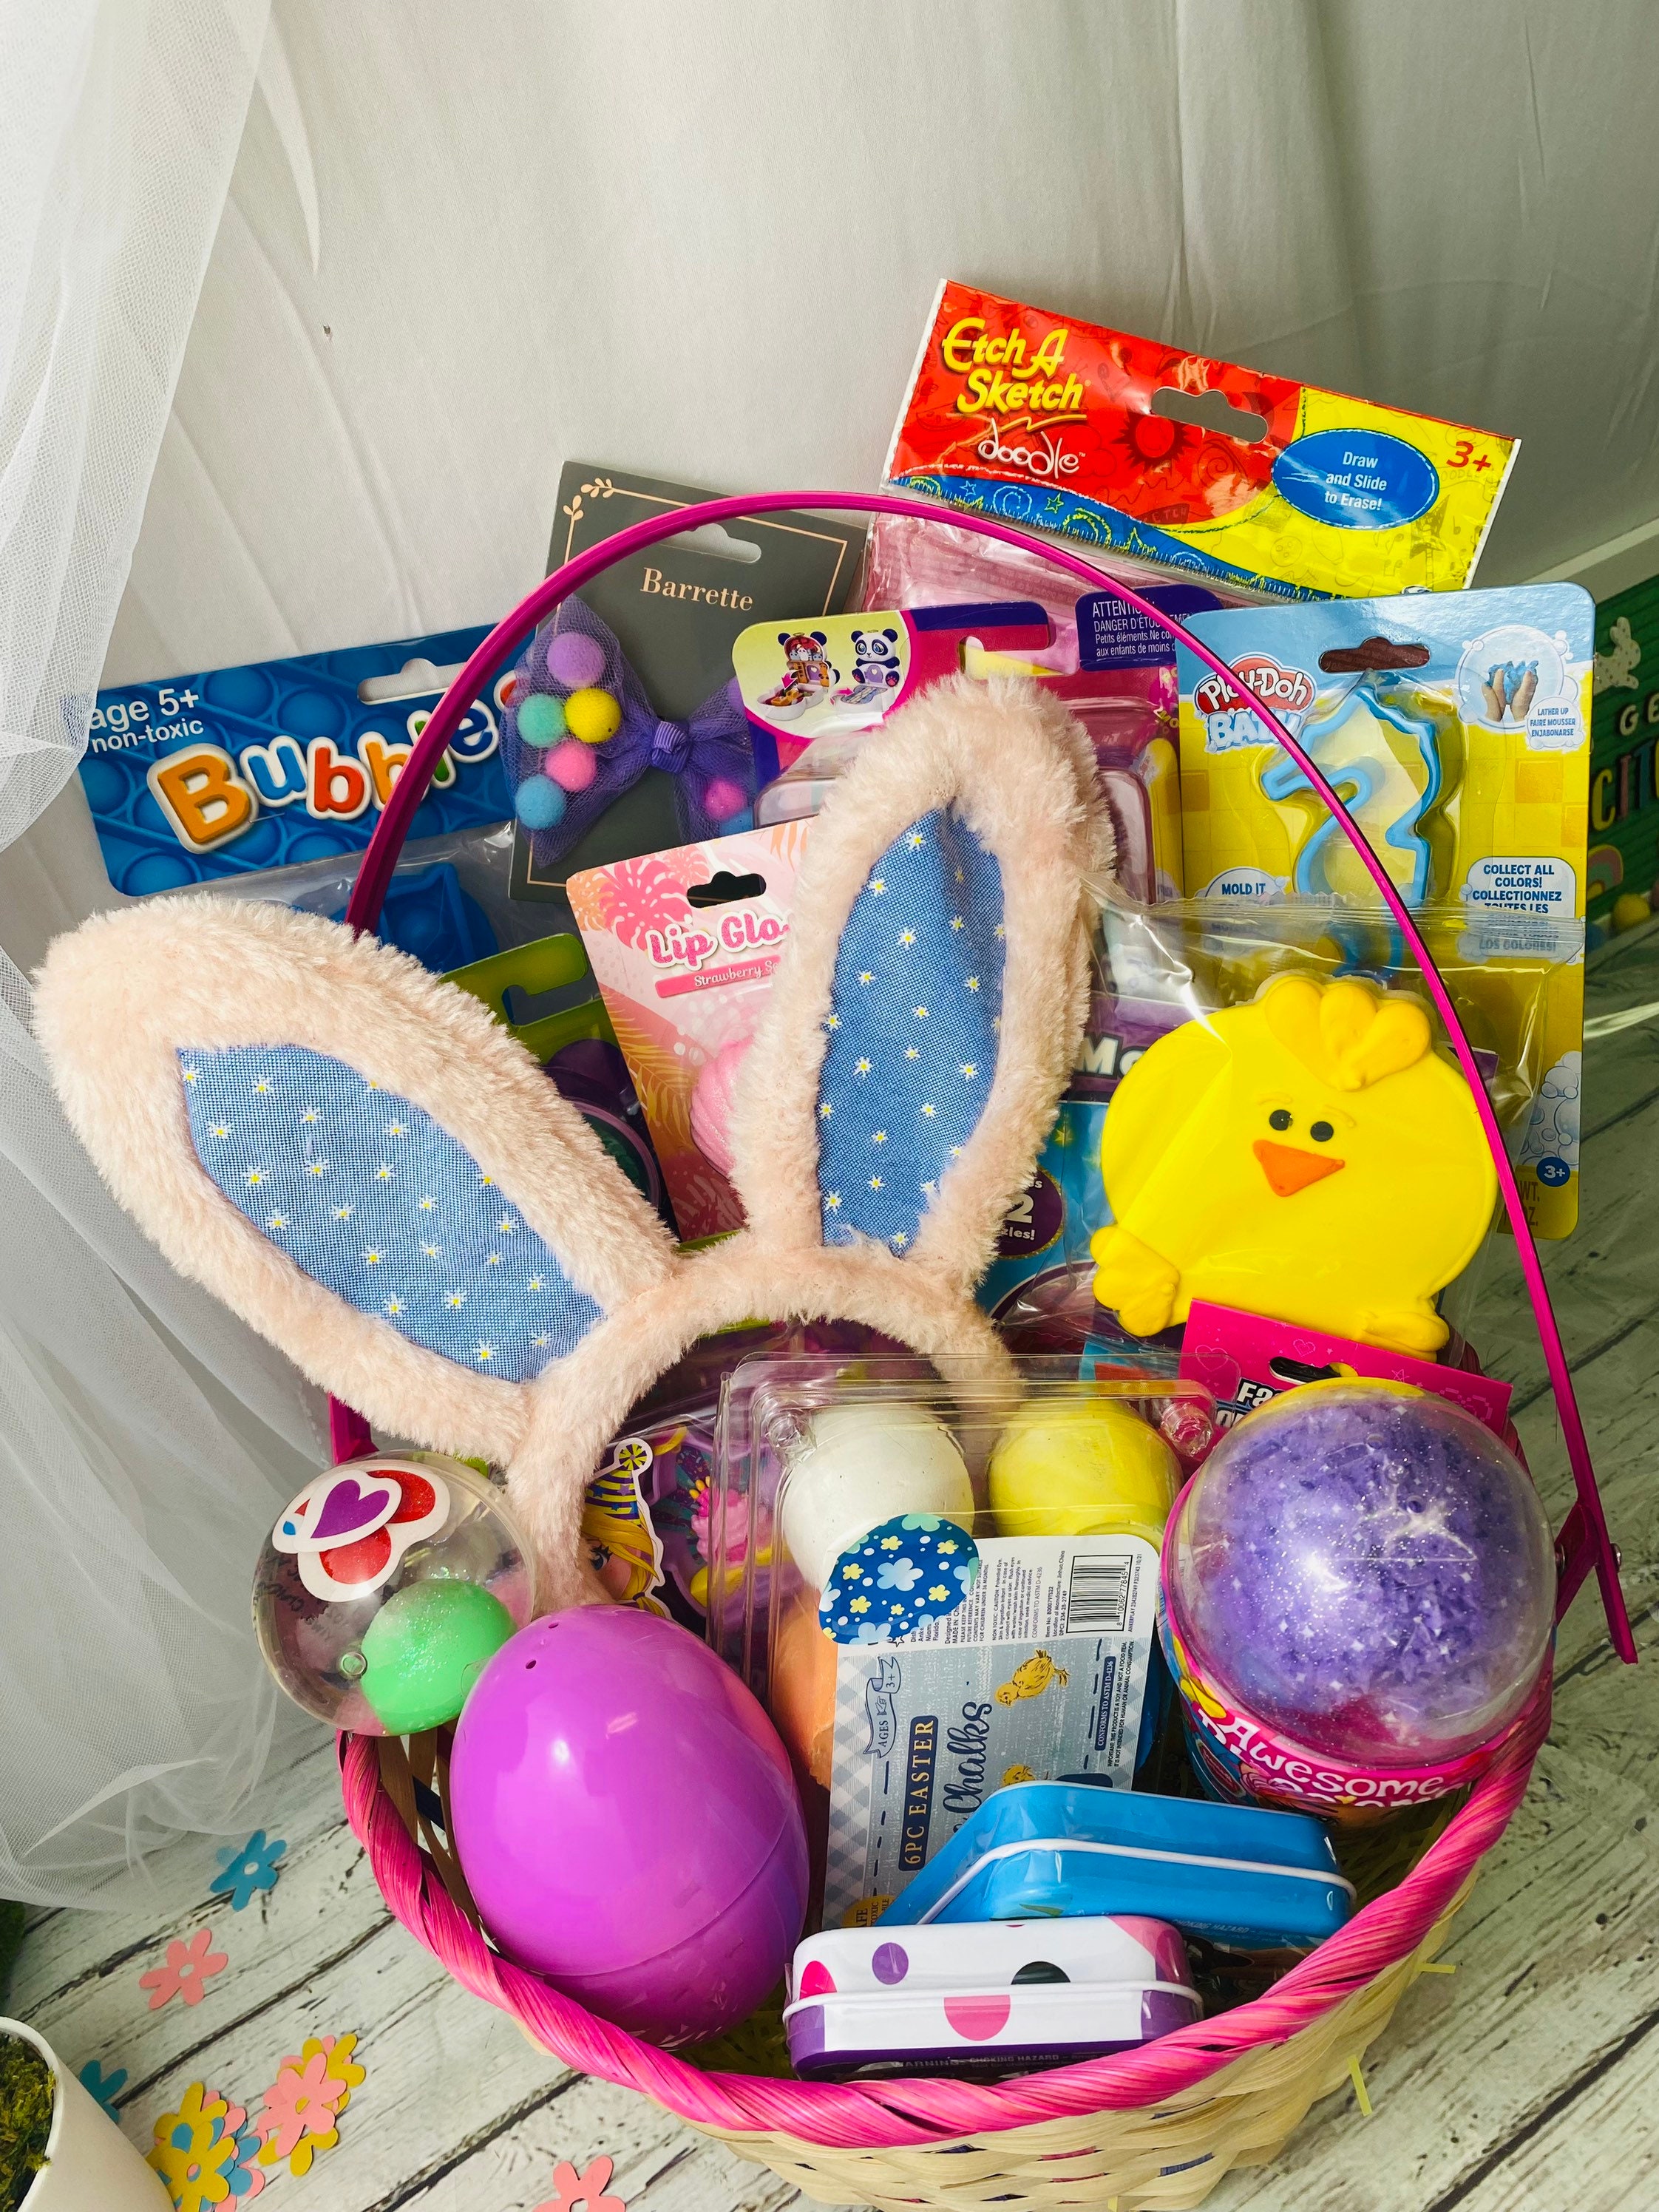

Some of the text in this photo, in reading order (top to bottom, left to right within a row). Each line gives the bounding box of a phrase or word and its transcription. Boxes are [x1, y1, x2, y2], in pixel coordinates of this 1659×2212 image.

[941, 317, 1069, 380] Etch A
[1343, 451, 1379, 469] Draw
[1446, 441, 1492, 472] 3+
[1326, 473, 1388, 491] and Slide
[1324, 491, 1382, 511] to Erase!
[640, 567, 754, 612] Barrette
[1094, 618, 1129, 633] DANGER
[1096, 634, 1115, 644] Petits
[1096, 648, 1109, 657] aux
[1110, 645, 1136, 657] enfants
[1138, 642, 1146, 654] de
[1148, 641, 1170, 653] moins
[89, 688, 200, 733] age 5+
[1538, 708, 1559, 716] LATHER
[1547, 718, 1575, 726] MOUSSER
[92, 717, 204, 753] non-toxic
[1532, 728, 1574, 737] ENJABONARSE
[1483, 864, 1554, 875] COLLECT ALL
[1222, 883, 1266, 895] MOLD IT
[1495, 877, 1543, 888] COLORS!
[1472, 890, 1561, 901] COLLECTIONNEZ
[648, 912, 791, 968] Lip Glo
[694, 963, 763, 988] Strawberry
[1544, 1164, 1566, 1179] 3+
[1526, 1206, 1538, 1227] Z.
[1119, 1572, 1128, 1592] 77845
[1117, 1594, 1125, 1615] 10062
[886, 1674, 895, 1688] 3+
[1097, 1660, 1113, 1746] CONFORMS TO ASTM D-4236
[879, 1720, 889, 1748] AGES
[943, 1701, 993, 1813] Chalks
[1213, 1715, 1444, 1798] Awesome
[904, 1720, 934, 1865] 6PC EASTER
[1212, 1924, 1249, 1934] HAZARD
